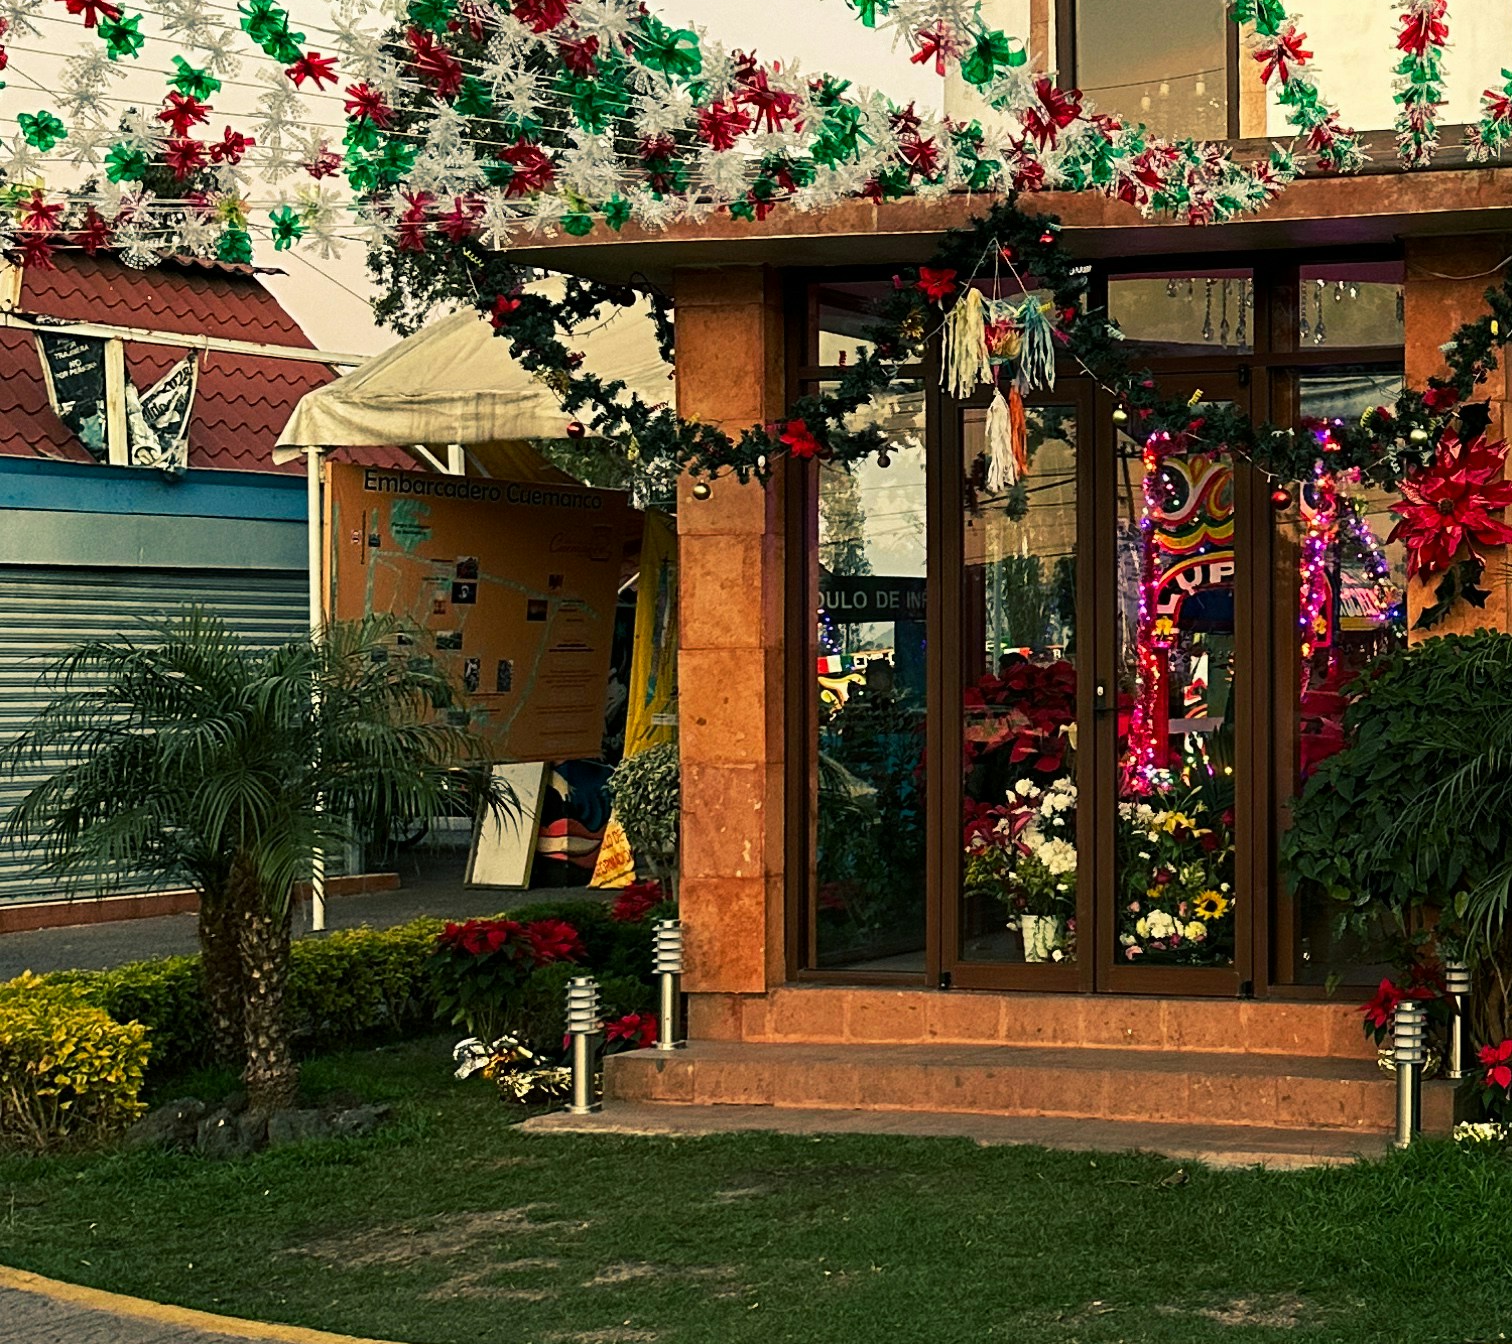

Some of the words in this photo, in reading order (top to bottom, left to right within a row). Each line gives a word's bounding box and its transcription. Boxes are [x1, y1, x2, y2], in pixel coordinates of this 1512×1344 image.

[364, 468, 500, 502] Embarcadero
[506, 482, 603, 509] Cuemanco
[876, 591, 900, 609] DE
